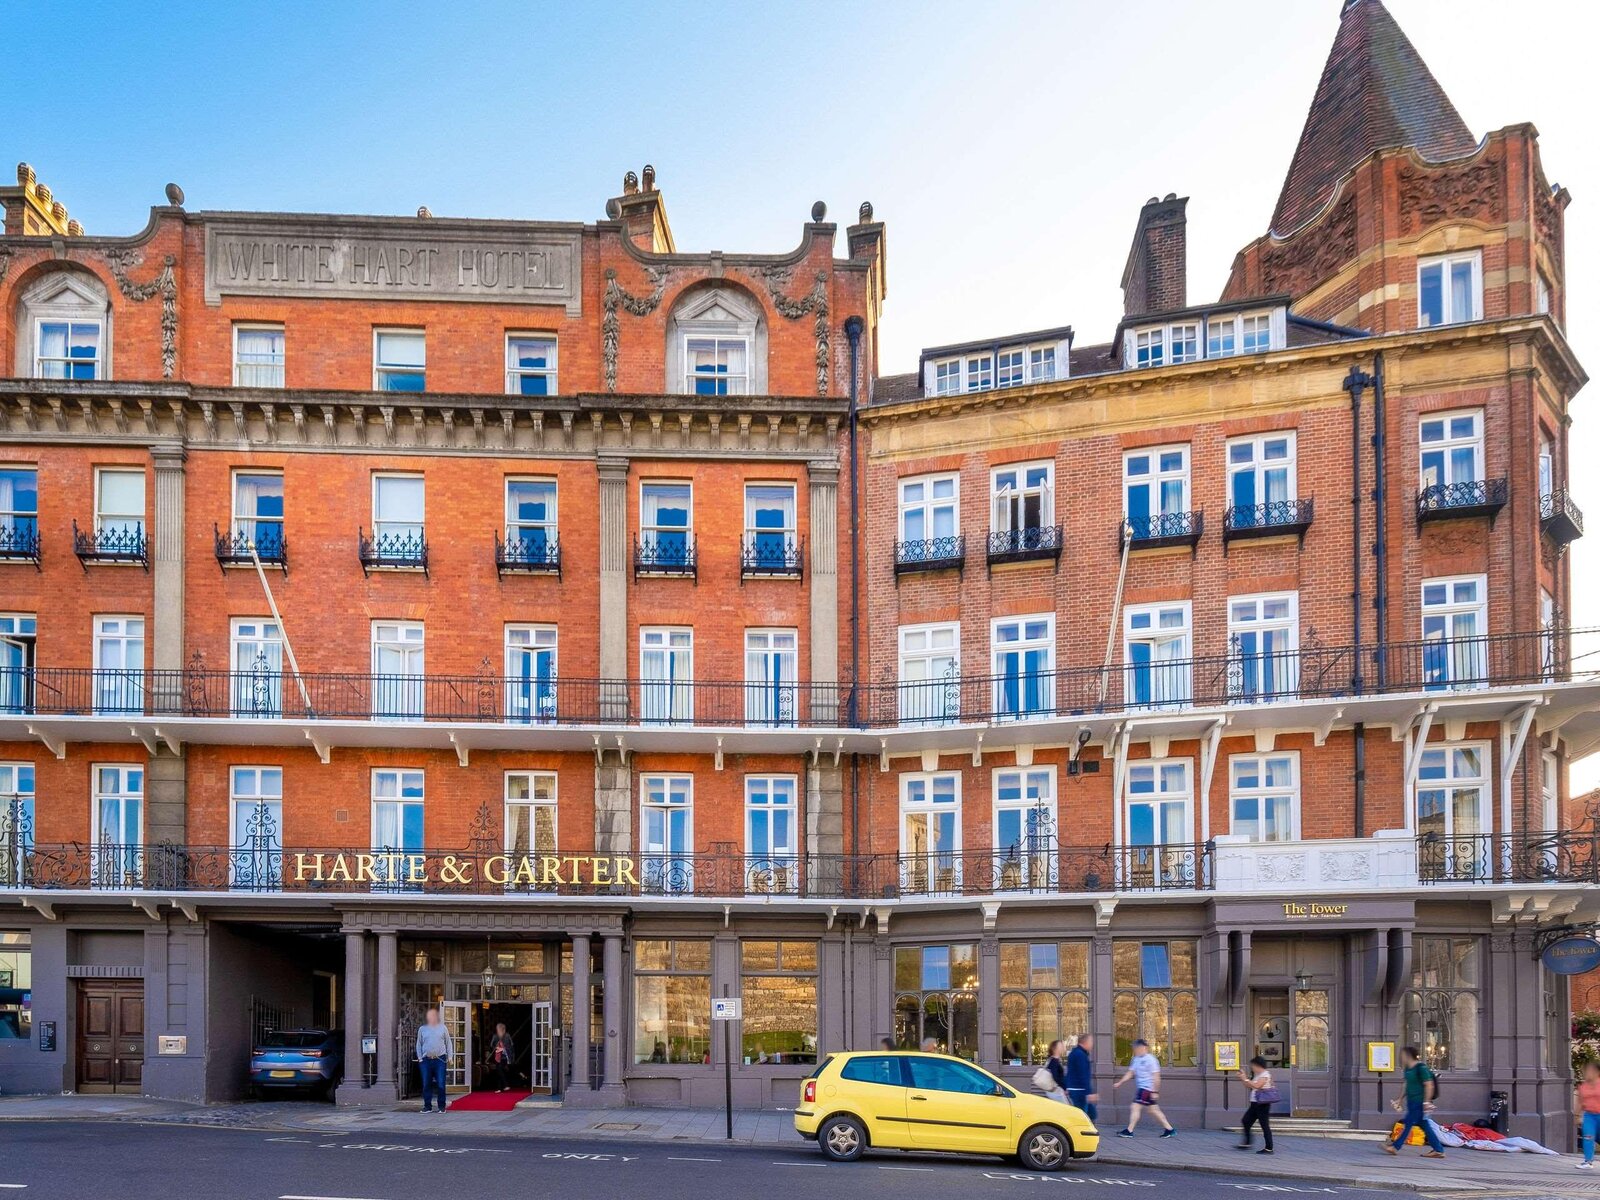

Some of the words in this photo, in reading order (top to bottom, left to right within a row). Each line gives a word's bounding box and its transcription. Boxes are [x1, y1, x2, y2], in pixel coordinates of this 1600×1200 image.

[223, 241, 335, 283] WHITE
[348, 245, 439, 287] HART
[456, 249, 565, 290] HOTEL
[294, 853, 429, 882] HARTE
[440, 855, 473, 884] &
[484, 855, 641, 886] GARTER
[1282, 903, 1307, 914] The
[1308, 903, 1348, 914] Tower
[318, 1143, 469, 1154] LOADING
[542, 1153, 639, 1162] ONLY
[982, 1172, 1158, 1187] LOADING
